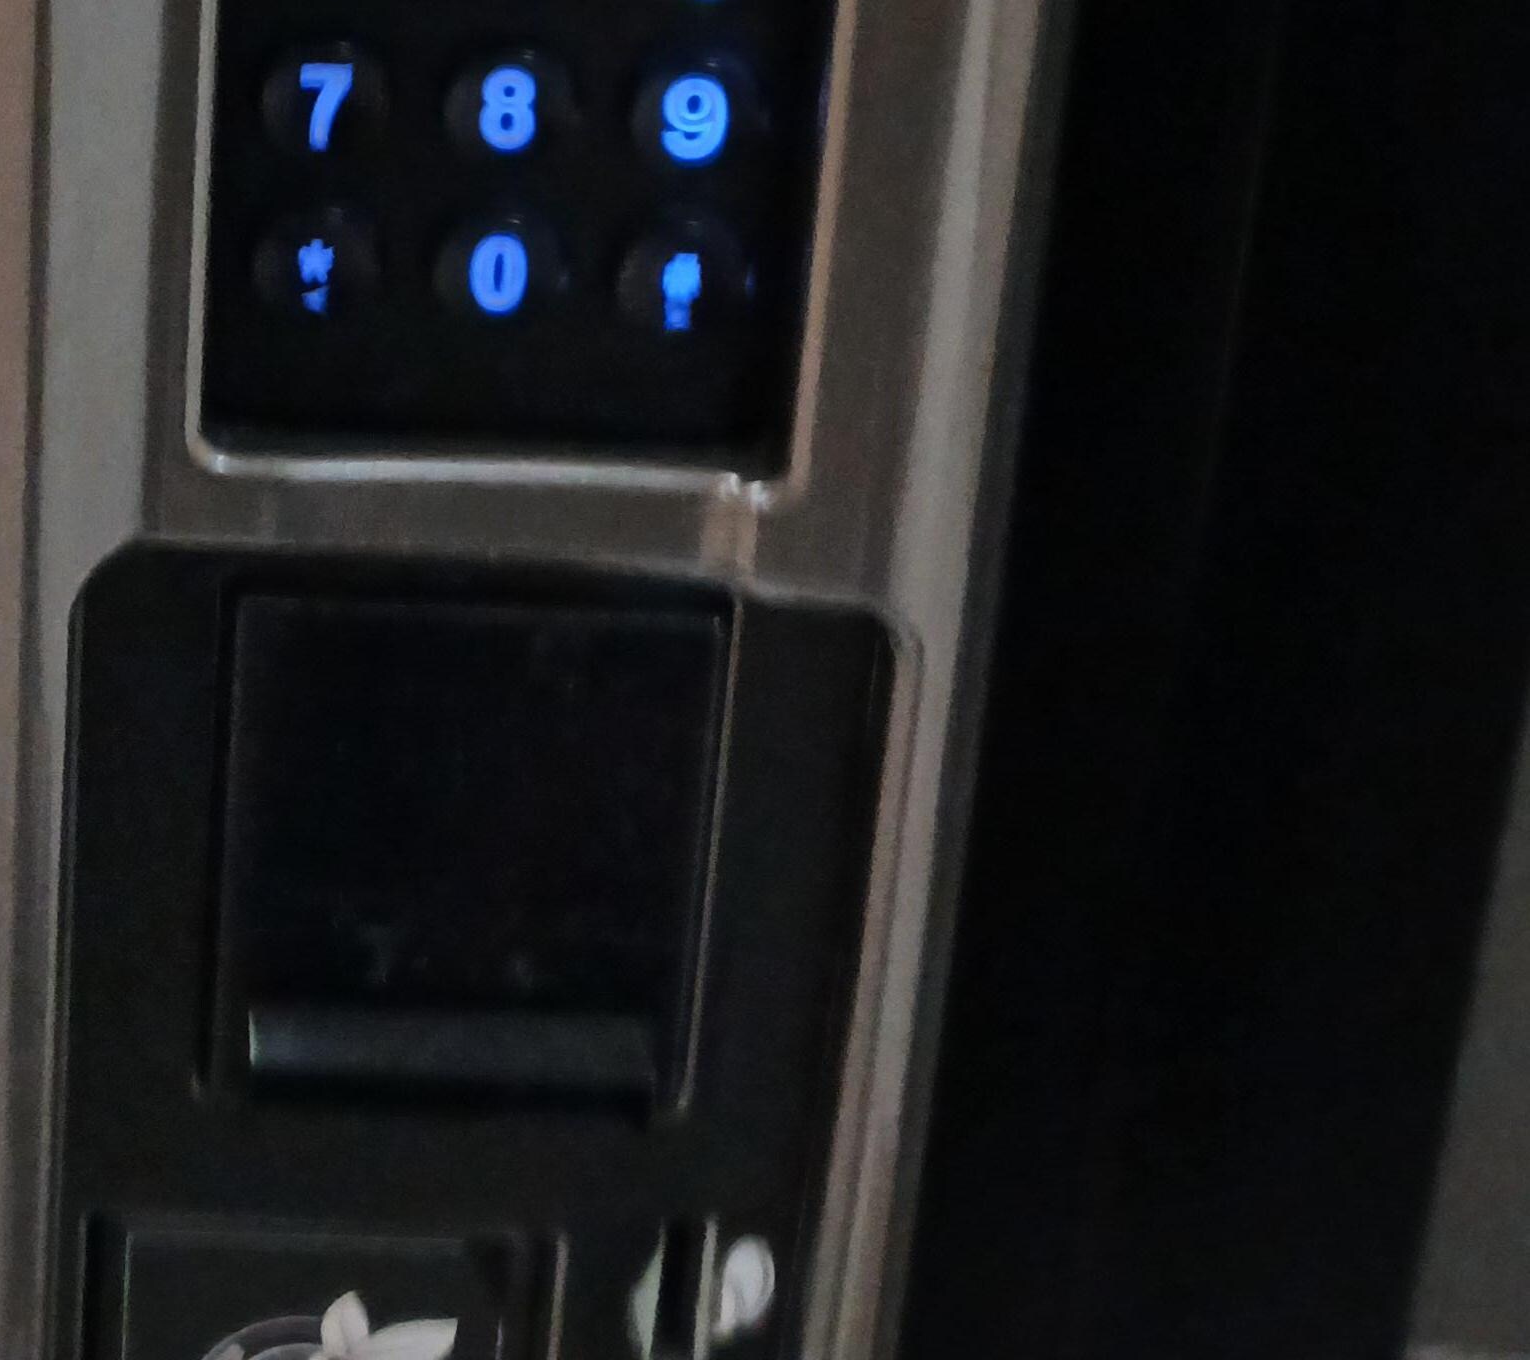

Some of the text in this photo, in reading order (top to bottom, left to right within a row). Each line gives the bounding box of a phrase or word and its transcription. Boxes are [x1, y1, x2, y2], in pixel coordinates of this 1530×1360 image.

[299, 62, 729, 161] 7 8 9
[469, 232, 529, 315] 0
